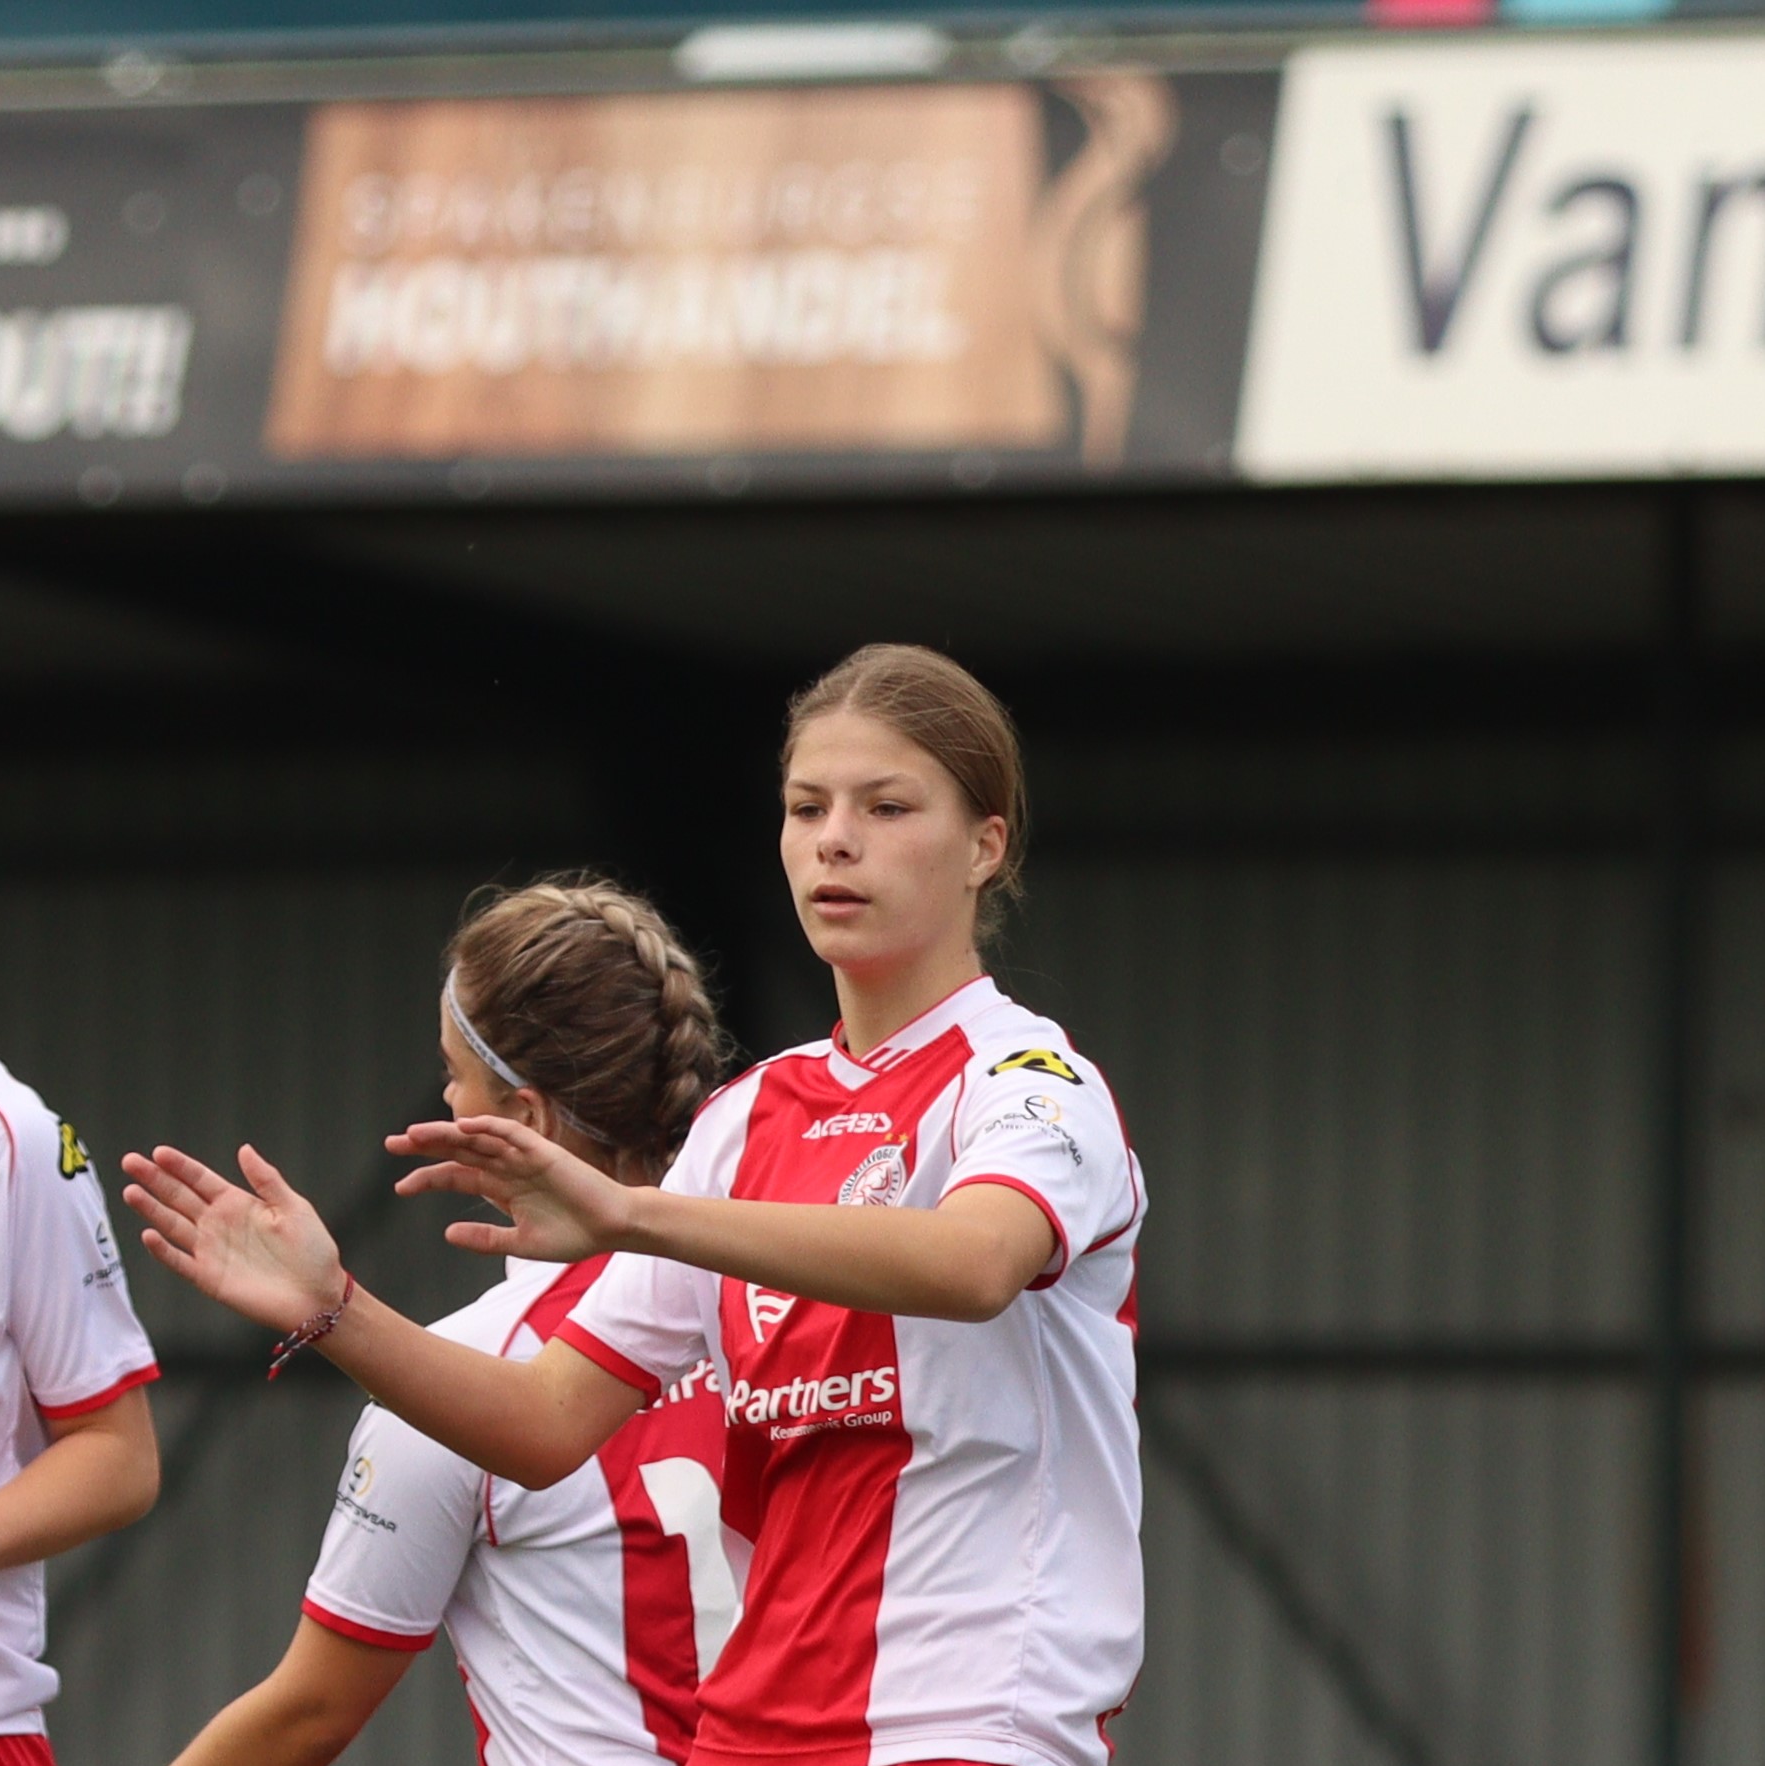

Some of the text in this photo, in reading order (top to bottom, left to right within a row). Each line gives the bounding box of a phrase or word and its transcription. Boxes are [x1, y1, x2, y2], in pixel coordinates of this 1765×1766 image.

[321, 246, 972, 378] HOUTHANDEL
[801, 1111, 893, 1140] ACERBIS
[843, 1410, 893, 1427] Group
